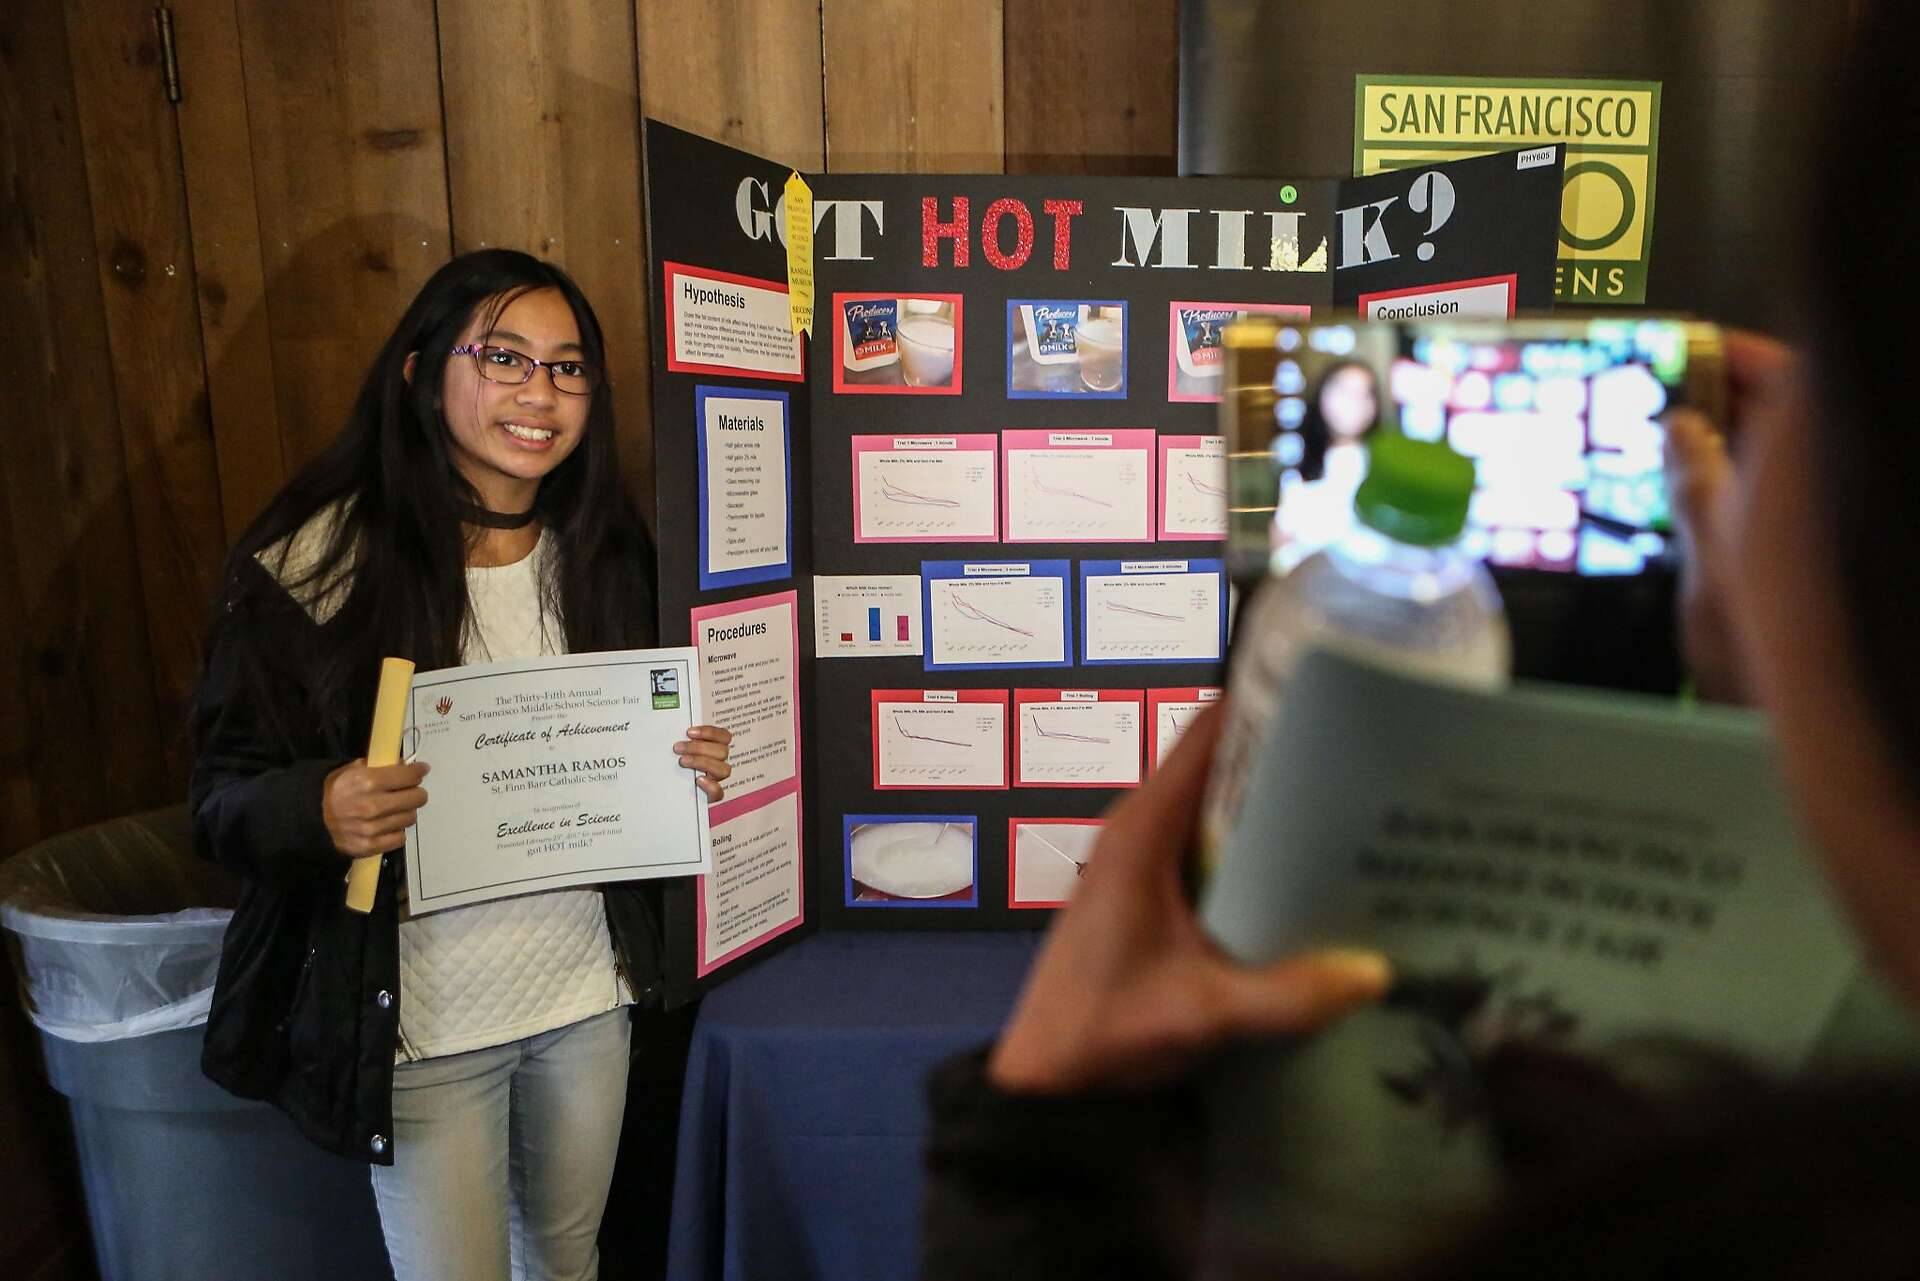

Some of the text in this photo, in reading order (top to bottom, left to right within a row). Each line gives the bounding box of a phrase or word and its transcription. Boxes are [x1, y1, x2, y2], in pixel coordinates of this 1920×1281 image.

[1380, 93, 1637, 137] SAN FRANCISCO
[1520, 151, 1551, 164] PHY605
[922, 197, 1084, 270] HOT
[1111, 171, 1456, 273] MILK?
[684, 282, 746, 309] Hypothesis
[848, 304, 894, 322] Producers
[1035, 307, 1076, 323] Producers
[1377, 300, 1459, 320] Conclusion
[864, 342, 887, 353] MILK
[1048, 343, 1068, 352] MILK
[719, 414, 764, 431] Materials
[708, 622, 766, 643] Procedures
[708, 652, 737, 663] Microwave
[496, 688, 602, 705] The Thirty-Fifth Annual
[460, 696, 640, 722] San Francisco Middle School Science Fair
[475, 721, 630, 750] Certificate of Achievement
[482, 757, 627, 784] SAMANTHA RAMOS
[505, 783, 526, 793] Finn
[528, 780, 546, 790] Barr
[549, 775, 585, 787] Catholic
[588, 772, 618, 782] School
[497, 813, 621, 838] Excellence in Science
[527, 838, 594, 857] got HOT milk?
[712, 833, 732, 847] Boiling
